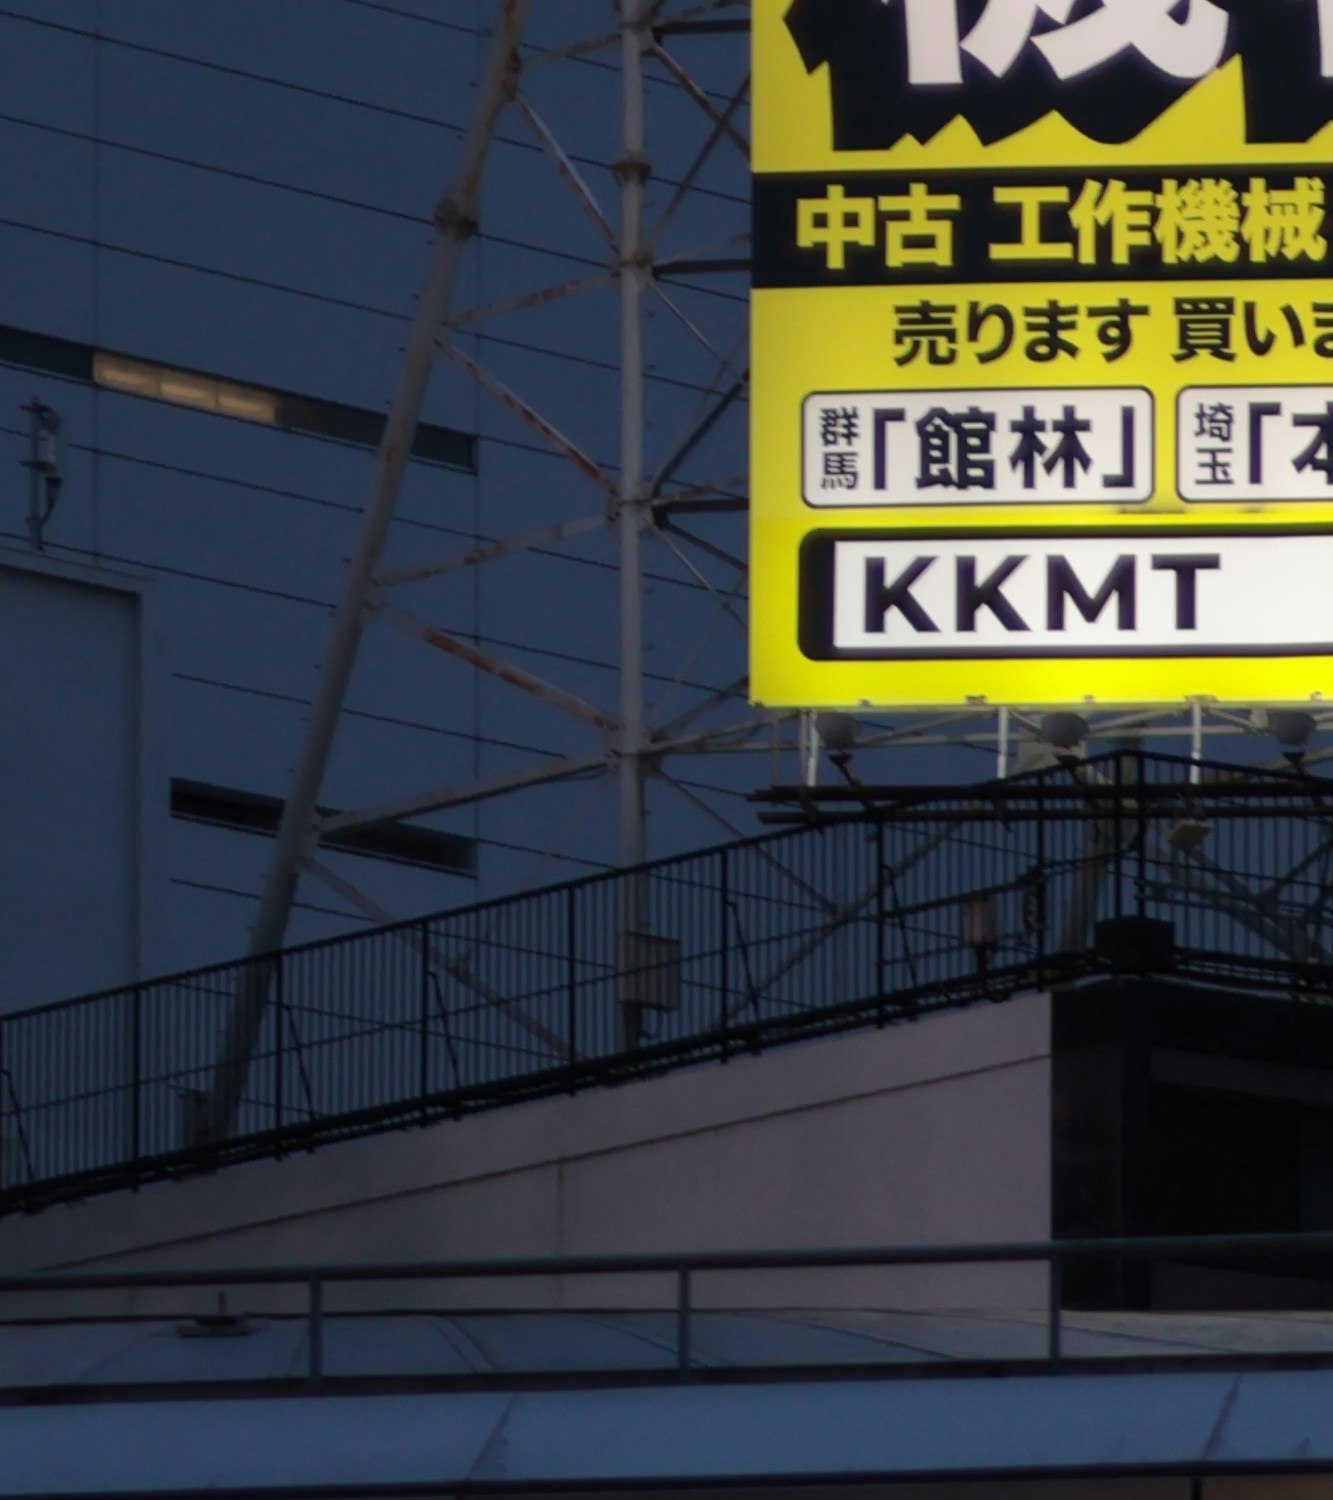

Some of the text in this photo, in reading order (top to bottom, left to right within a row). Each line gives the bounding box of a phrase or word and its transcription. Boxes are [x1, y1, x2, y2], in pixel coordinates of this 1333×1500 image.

[795, 183, 959, 270] 中古
[893, 300, 1150, 366] 売ります
[818, 405, 860, 491] 群馬
[1194, 400, 1234, 486] 埼玉
[862, 553, 1222, 633] KKMT
